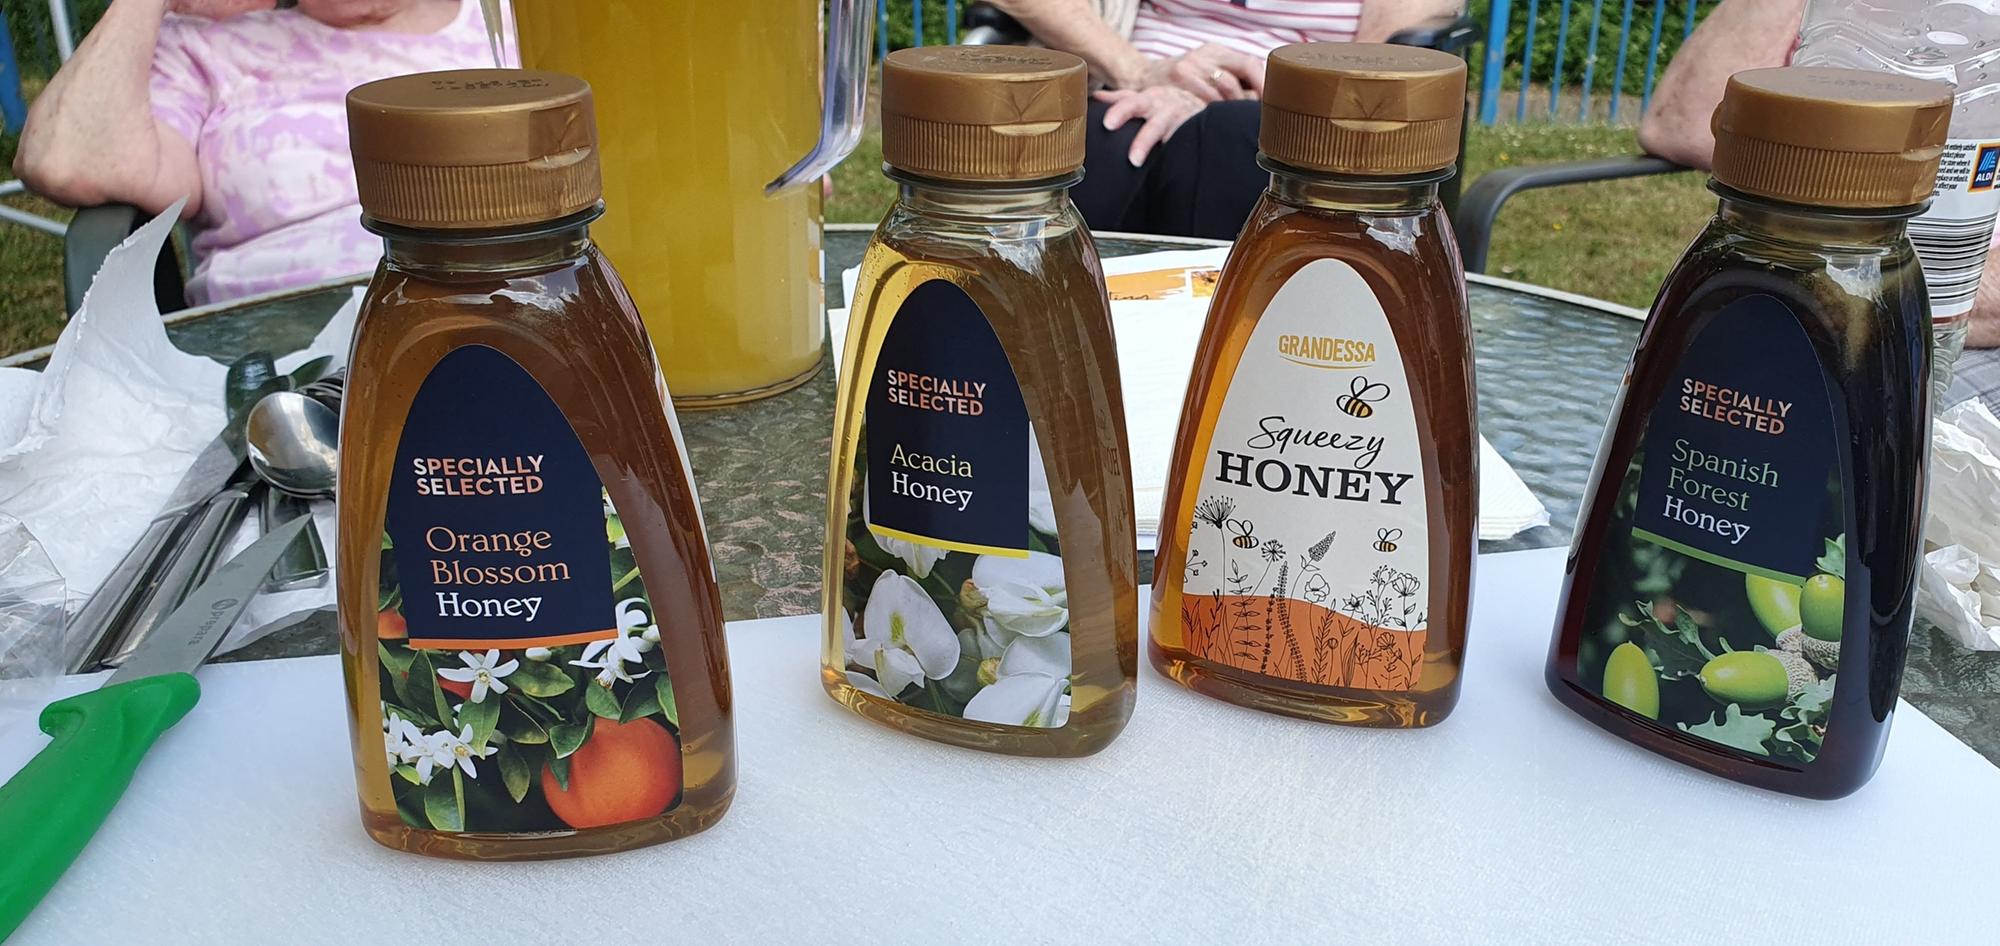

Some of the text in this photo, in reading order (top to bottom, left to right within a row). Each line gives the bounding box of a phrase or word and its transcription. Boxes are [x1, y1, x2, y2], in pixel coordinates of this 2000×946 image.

[1976, 172, 1994, 181] ALDI
[1278, 334, 1376, 362] GRANDESSA
[887, 369, 987, 398] SPECIALLY
[1682, 378, 1793, 418] SPECIALLY
[888, 387, 984, 416] SELECTED
[1679, 395, 1785, 435] SELECTED
[1247, 416, 1385, 470] Squeezy
[413, 455, 544, 476] SPECIALLY
[890, 443, 974, 478] Acacia
[1671, 438, 1779, 488] Spanish
[416, 475, 544, 496] SELECTED
[891, 471, 974, 511] Honey
[1215, 450, 1414, 505] HONEY
[1667, 466, 1750, 511] Forest
[1662, 494, 1751, 545] Honey
[426, 526, 552, 557] Orange
[430, 559, 571, 585] Blossom
[435, 591, 542, 622] Honey
